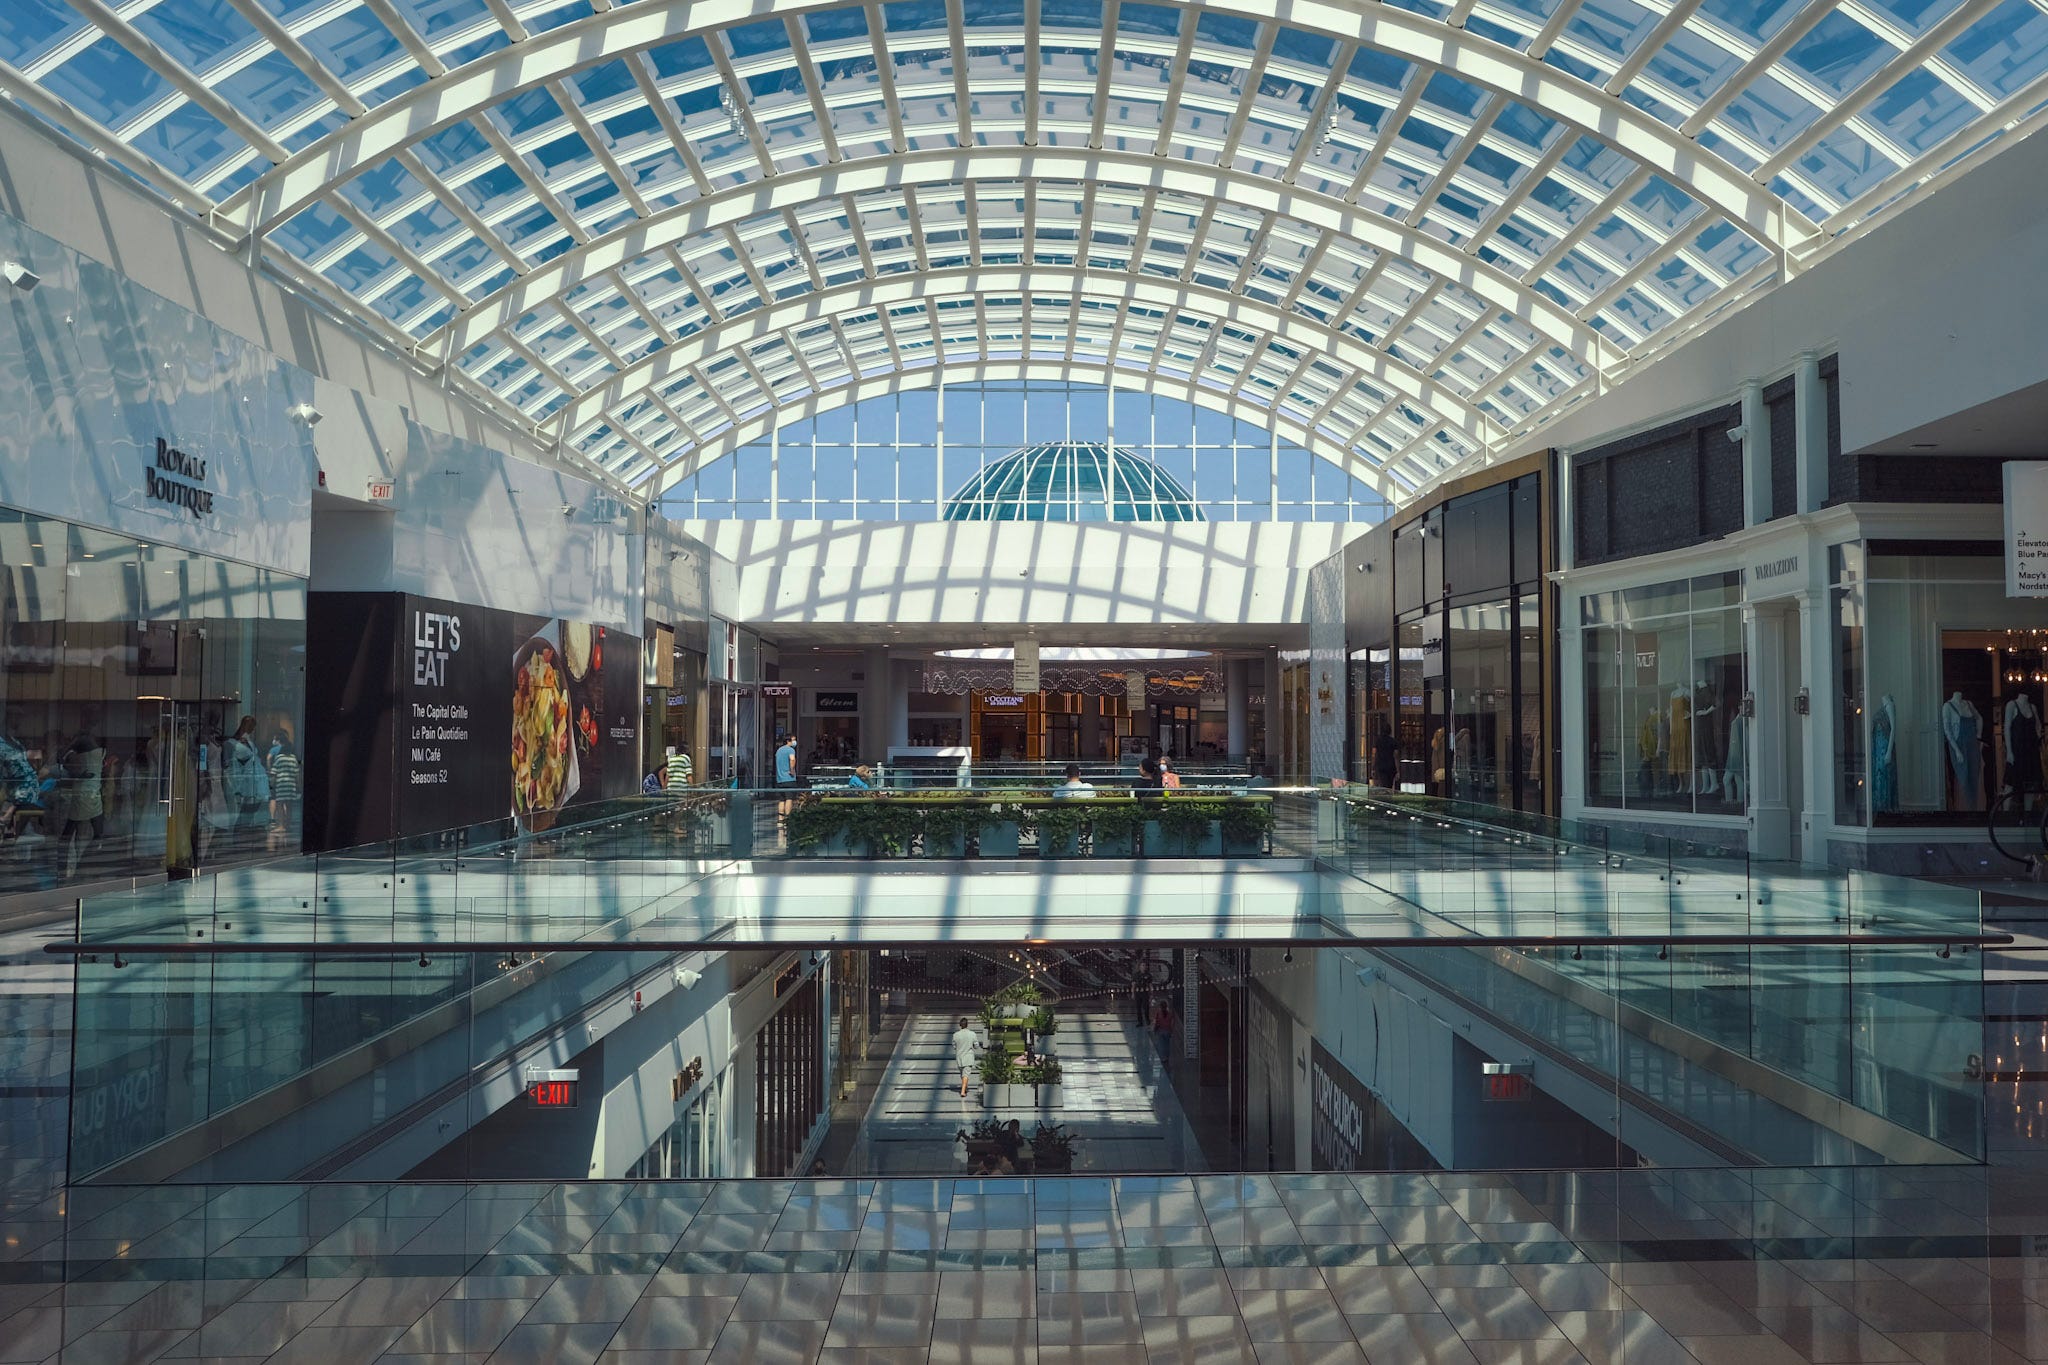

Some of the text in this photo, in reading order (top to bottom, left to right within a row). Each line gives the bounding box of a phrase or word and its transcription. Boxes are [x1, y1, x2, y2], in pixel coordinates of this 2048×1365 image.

[156, 437, 207, 481] ROYALS
[146, 466, 213, 519] BOUTIQUE
[373, 484, 391, 498] EXIT
[2018, 550, 2048, 558] Blue Pa
[1755, 556, 1798, 580] VARIAZIONI
[2018, 571, 2046, 581] Macy's
[414, 610, 462, 651] LET'S
[413, 650, 449, 687] EAT
[764, 686, 790, 695] TUMI
[984, 695, 1024, 703] L'OCCITANE
[412, 703, 468, 721] The Capital Grille
[412, 726, 468, 741] Le Pain Quotidien
[411, 747, 441, 762] NM Café
[410, 769, 448, 784] Seasons 52
[537, 1082, 569, 1105] EXIT
[1313, 1062, 1363, 1156] TORY BURCH
